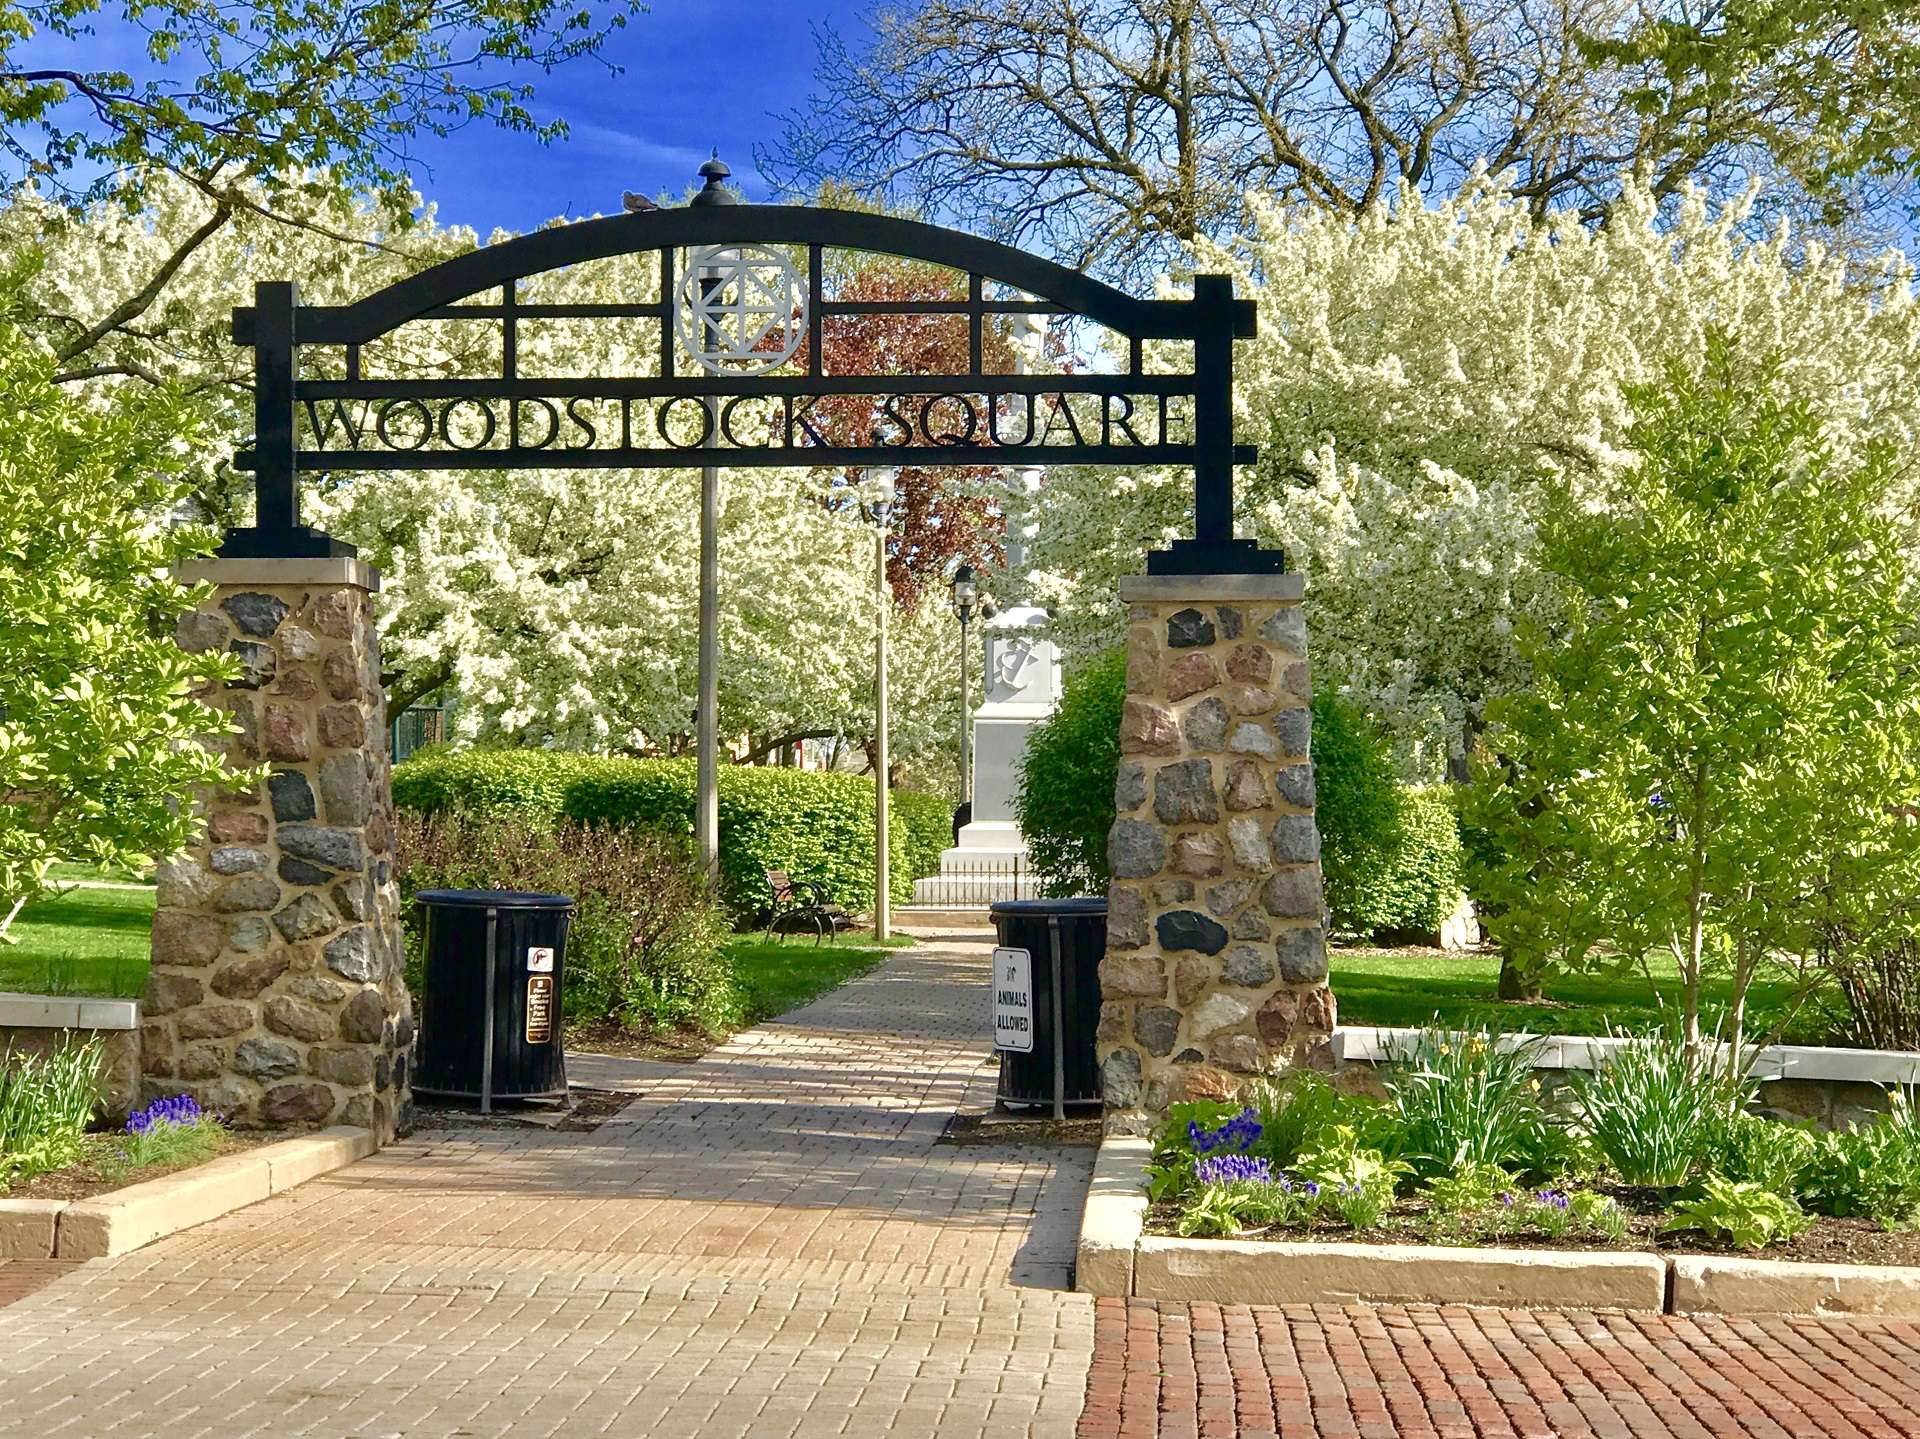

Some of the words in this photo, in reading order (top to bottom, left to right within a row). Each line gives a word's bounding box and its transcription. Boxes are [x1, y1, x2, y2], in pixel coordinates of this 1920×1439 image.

[302, 396, 831, 451] WOODSTOCK
[880, 392, 1192, 448] SQUARE
[997, 990, 1028, 1007] ANIMALS
[997, 1014, 1029, 1032] ALLOWED
